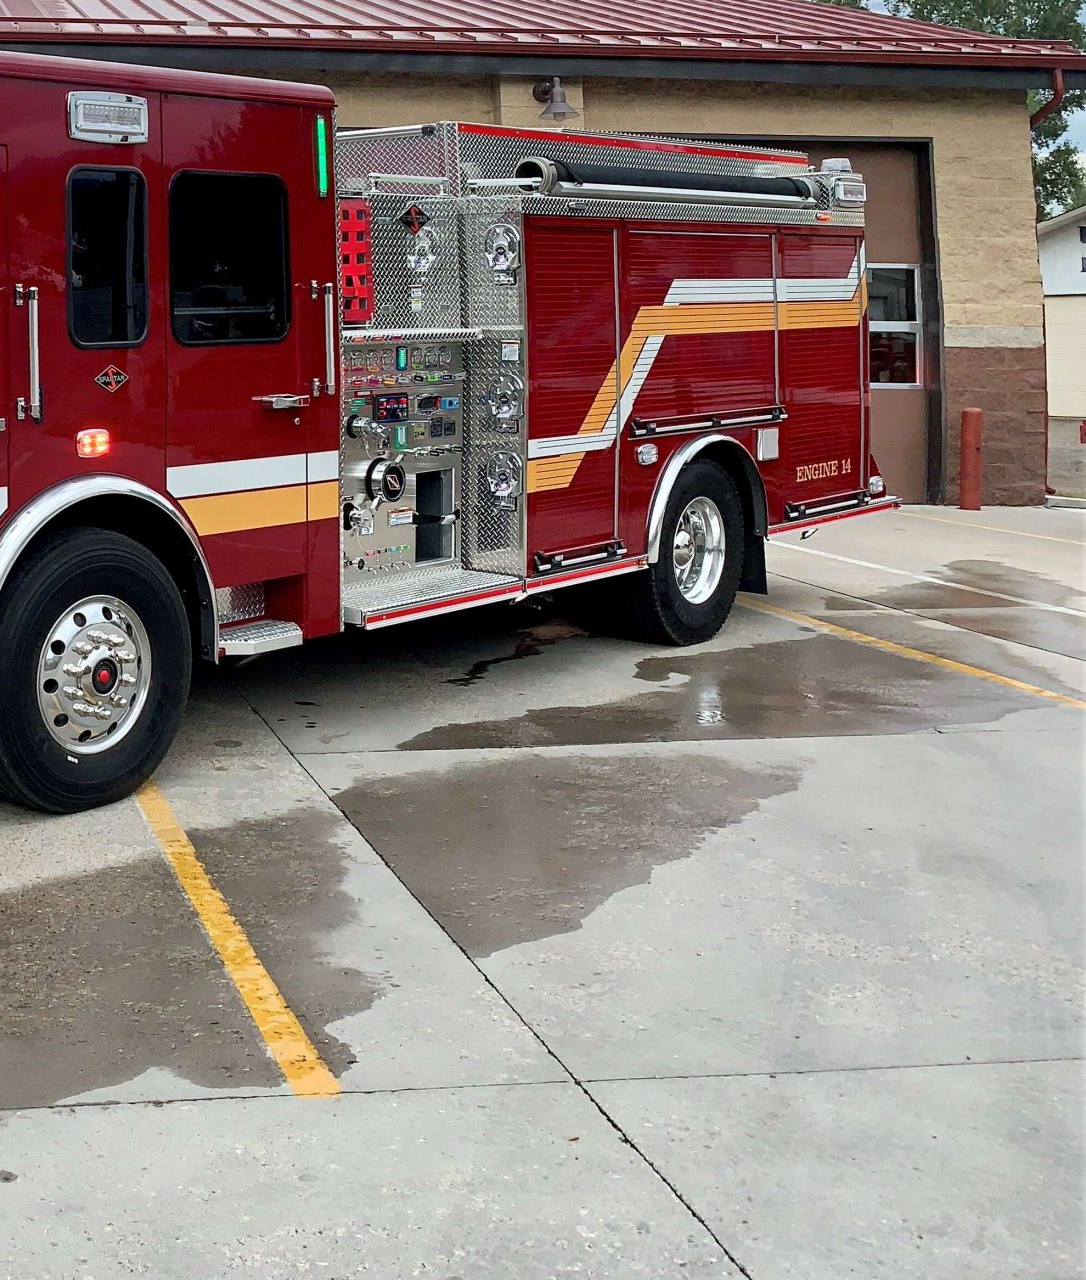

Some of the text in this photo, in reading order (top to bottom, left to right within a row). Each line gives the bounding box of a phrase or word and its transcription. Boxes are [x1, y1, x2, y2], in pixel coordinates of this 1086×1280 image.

[98, 374, 125, 383] SPARTAN
[796, 458, 852, 482] ENGINE 14
